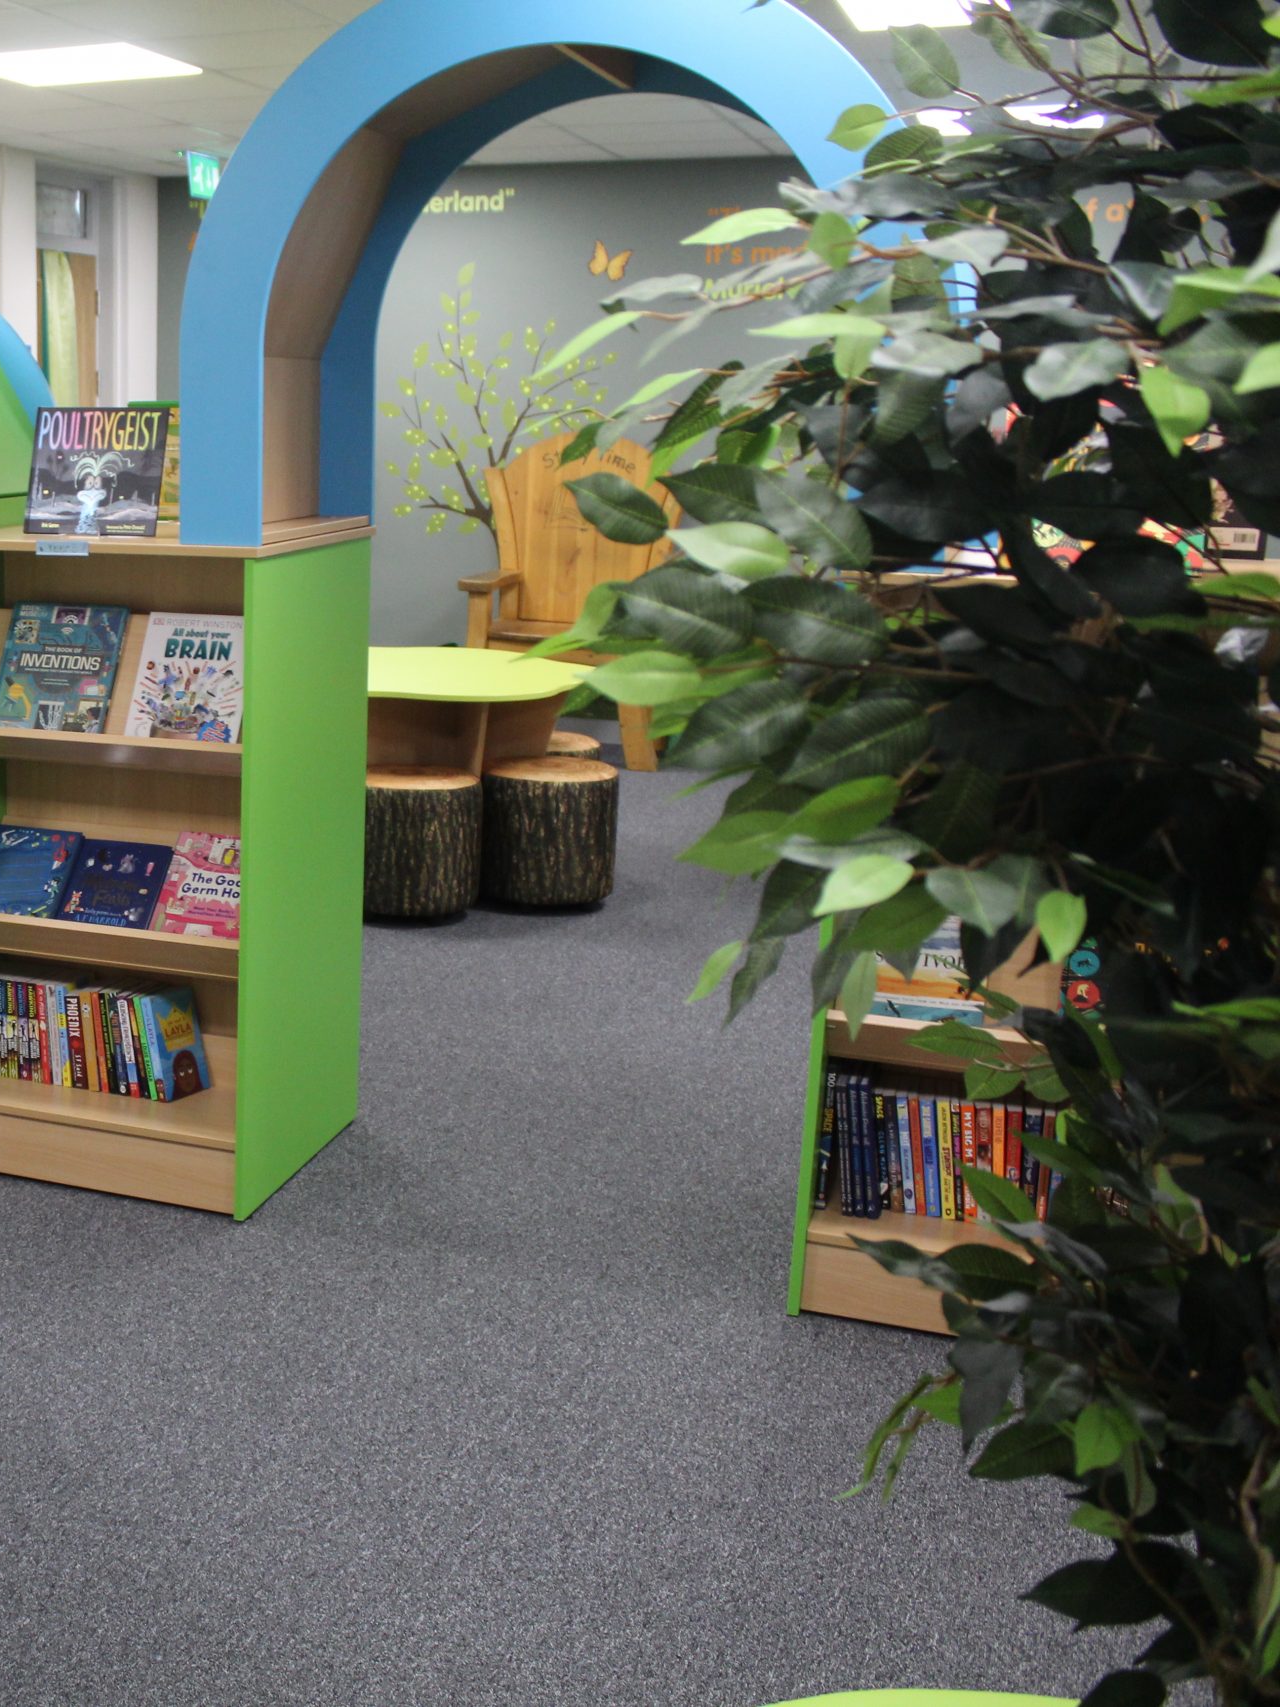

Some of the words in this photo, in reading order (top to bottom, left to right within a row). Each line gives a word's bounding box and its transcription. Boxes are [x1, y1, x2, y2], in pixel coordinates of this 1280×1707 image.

[422, 188, 515, 213] erland"
[38, 411, 162, 450] POULTRYGEIST
[172, 628, 185, 637] All
[185, 628, 209, 638] about
[211, 631, 231, 639] your
[165, 638, 233, 661] BRAIN
[20, 653, 101, 671] INVENTIONS
[192, 872, 213, 884] The
[181, 883, 218, 896] Germ
[66, 998, 80, 1037] PHOENIX
[827, 1073, 836, 1088] 100
[875, 1096, 884, 1119] SPACE
[822, 1108, 834, 1133] SPACE
[964, 1112, 972, 1127] MY
